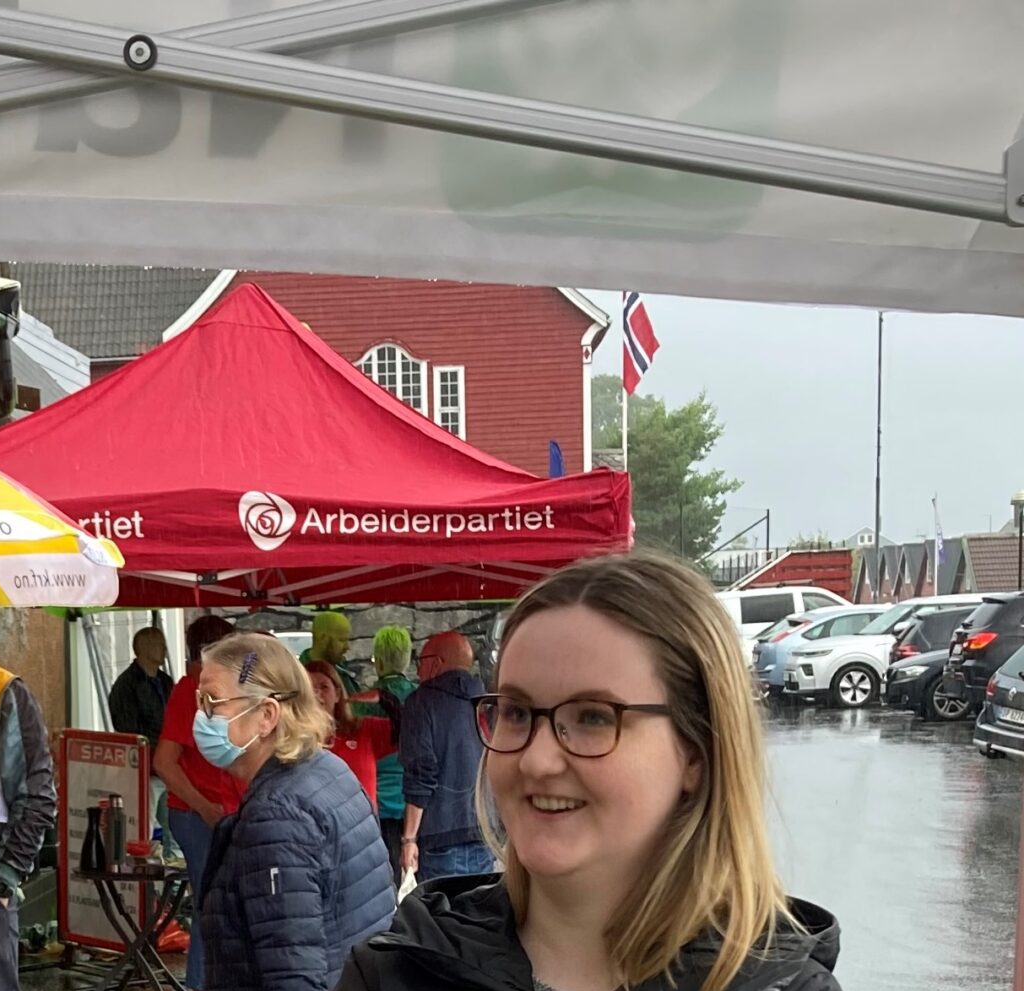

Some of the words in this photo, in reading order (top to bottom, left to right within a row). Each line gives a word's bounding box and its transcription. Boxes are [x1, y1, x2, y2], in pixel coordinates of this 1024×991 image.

[78, 509, 145, 541] rtiet
[299, 504, 555, 538] Arbeiderpartiet
[80, 744, 126, 767] SPAR
